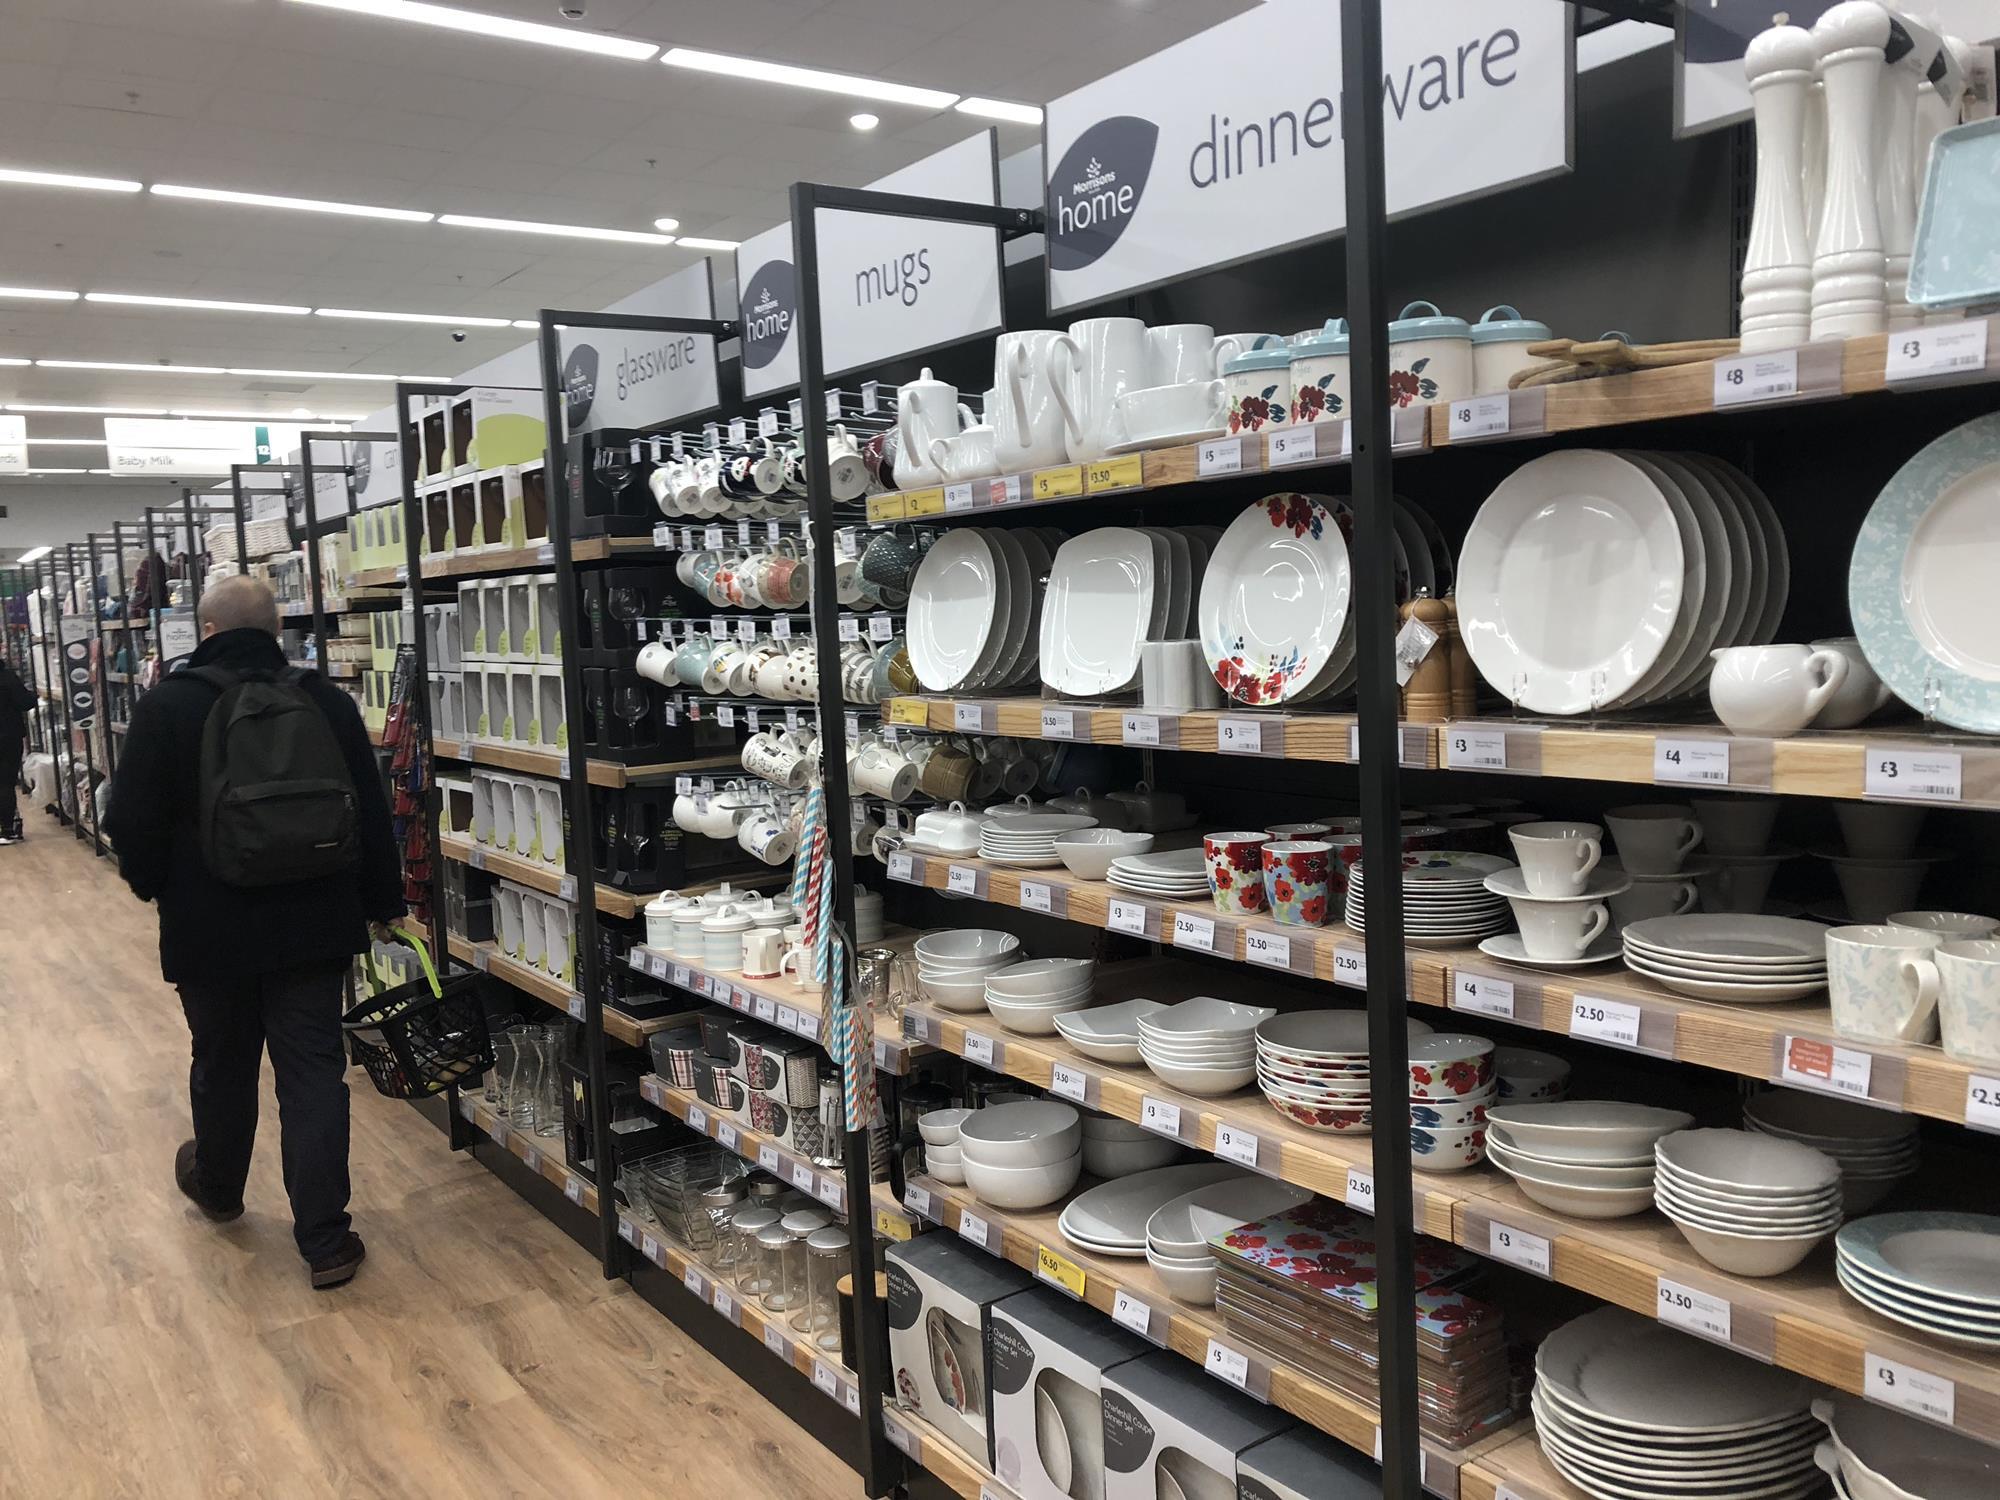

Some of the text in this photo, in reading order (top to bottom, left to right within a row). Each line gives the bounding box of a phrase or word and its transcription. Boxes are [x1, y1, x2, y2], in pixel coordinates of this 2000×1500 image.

[1073, 171, 1116, 195] Morrisons
[1058, 185, 1134, 235] home
[856, 246, 931, 306] mugs
[745, 310, 789, 343] home
[1902, 340, 1921, 358] £3
[616, 335, 695, 401] glassware
[1726, 368, 1744, 385] £8
[1458, 408, 1471, 423] £8
[1275, 438, 1286, 453] £5
[117, 455, 175, 468] Baby Milk
[1204, 448, 1215, 463] £5
[1090, 470, 1111, 484] £3.50
[1042, 715, 1057, 728] £3.50
[1127, 720, 1137, 733] £4
[1223, 726, 1234, 739] £3
[1455, 739, 1467, 753] £3
[1665, 749, 1681, 765] £4
[1880, 761, 1899, 778] £3
[950, 870, 962, 882] £2.50
[1114, 907, 1122, 919] £3
[1176, 920, 1194, 933] £2.50
[1247, 936, 1267, 950] £2.50
[1335, 955, 1358, 970] £2.50
[1464, 982, 1477, 996] £4
[1575, 1005, 1605, 1022] £2.50
[966, 1036, 979, 1049] £2.50
[1055, 1070, 1069, 1084] £3.50
[1147, 1104, 1156, 1117] £3
[1221, 1131, 1231, 1145] £3
[906, 1186, 918, 1200] £1.50
[1349, 1178, 1371, 1196] £2.50
[964, 1216, 972, 1229] £5
[1499, 1231, 1511, 1247] £3
[1040, 1252, 1058, 1272] £6.50
[1119, 1299, 1128, 1312] £7
[1660, 1287, 1692, 1309] £2.50
[993, 1336, 1018, 1359] Dinner Set
[1213, 1348, 1222, 1363] £5
[1879, 1366, 1896, 1387] £3
[1104, 1409, 1123, 1427] Dinner
[1123, 1421, 1134, 1435] Set
[1132, 1416, 1153, 1436] Coupe
